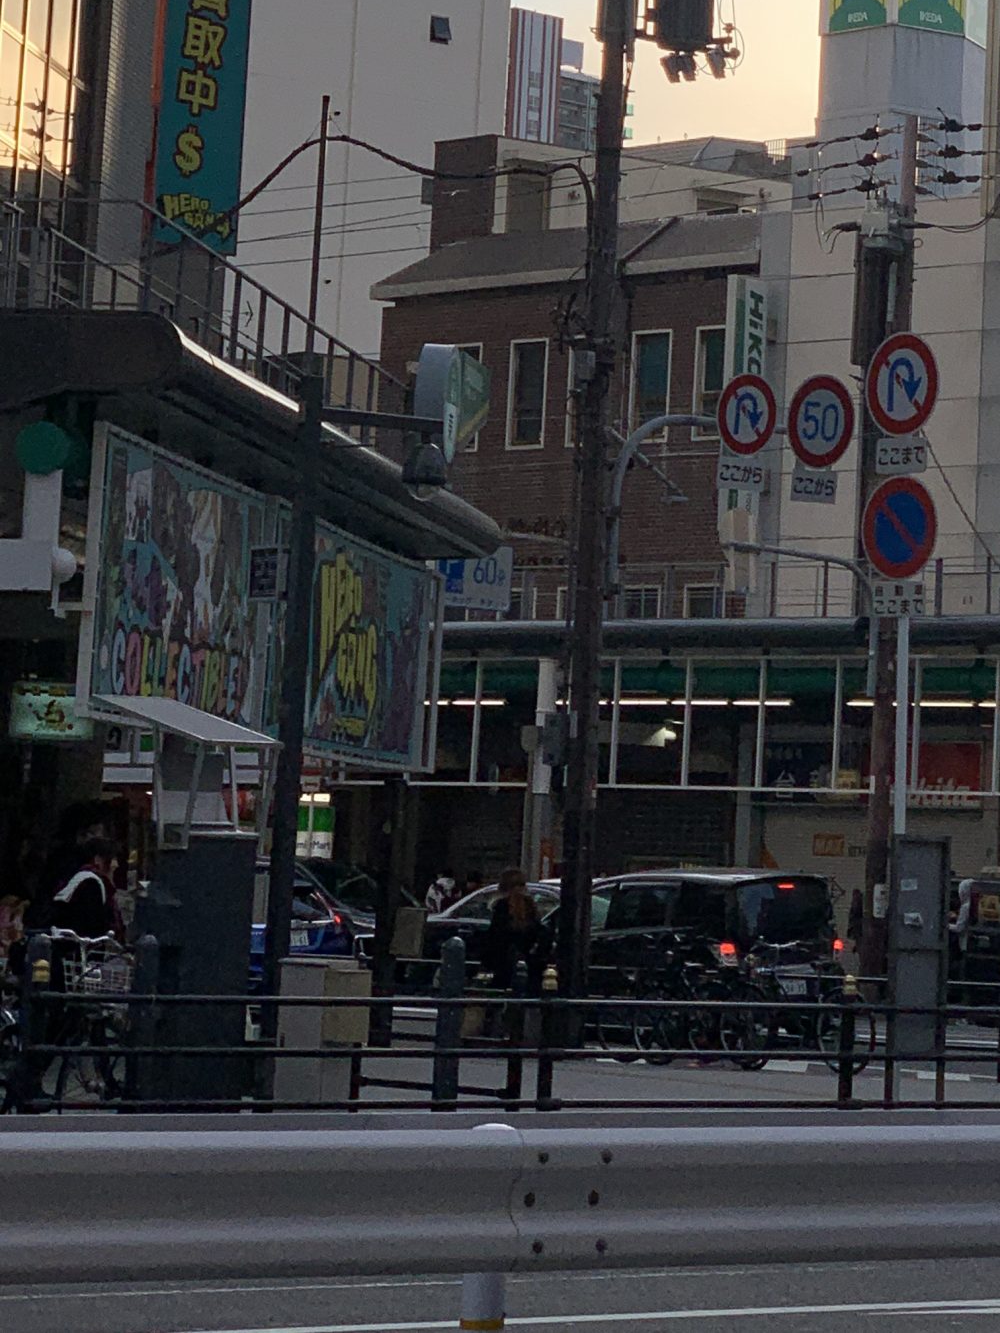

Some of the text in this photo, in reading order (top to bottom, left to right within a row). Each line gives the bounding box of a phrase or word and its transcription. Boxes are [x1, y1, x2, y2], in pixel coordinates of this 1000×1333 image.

[802, 401, 840, 443] 50
[877, 445, 927, 467] ここまで
[718, 462, 763, 485] ここから
[793, 476, 835, 498] ここから
[874, 598, 924, 616] ここまで
